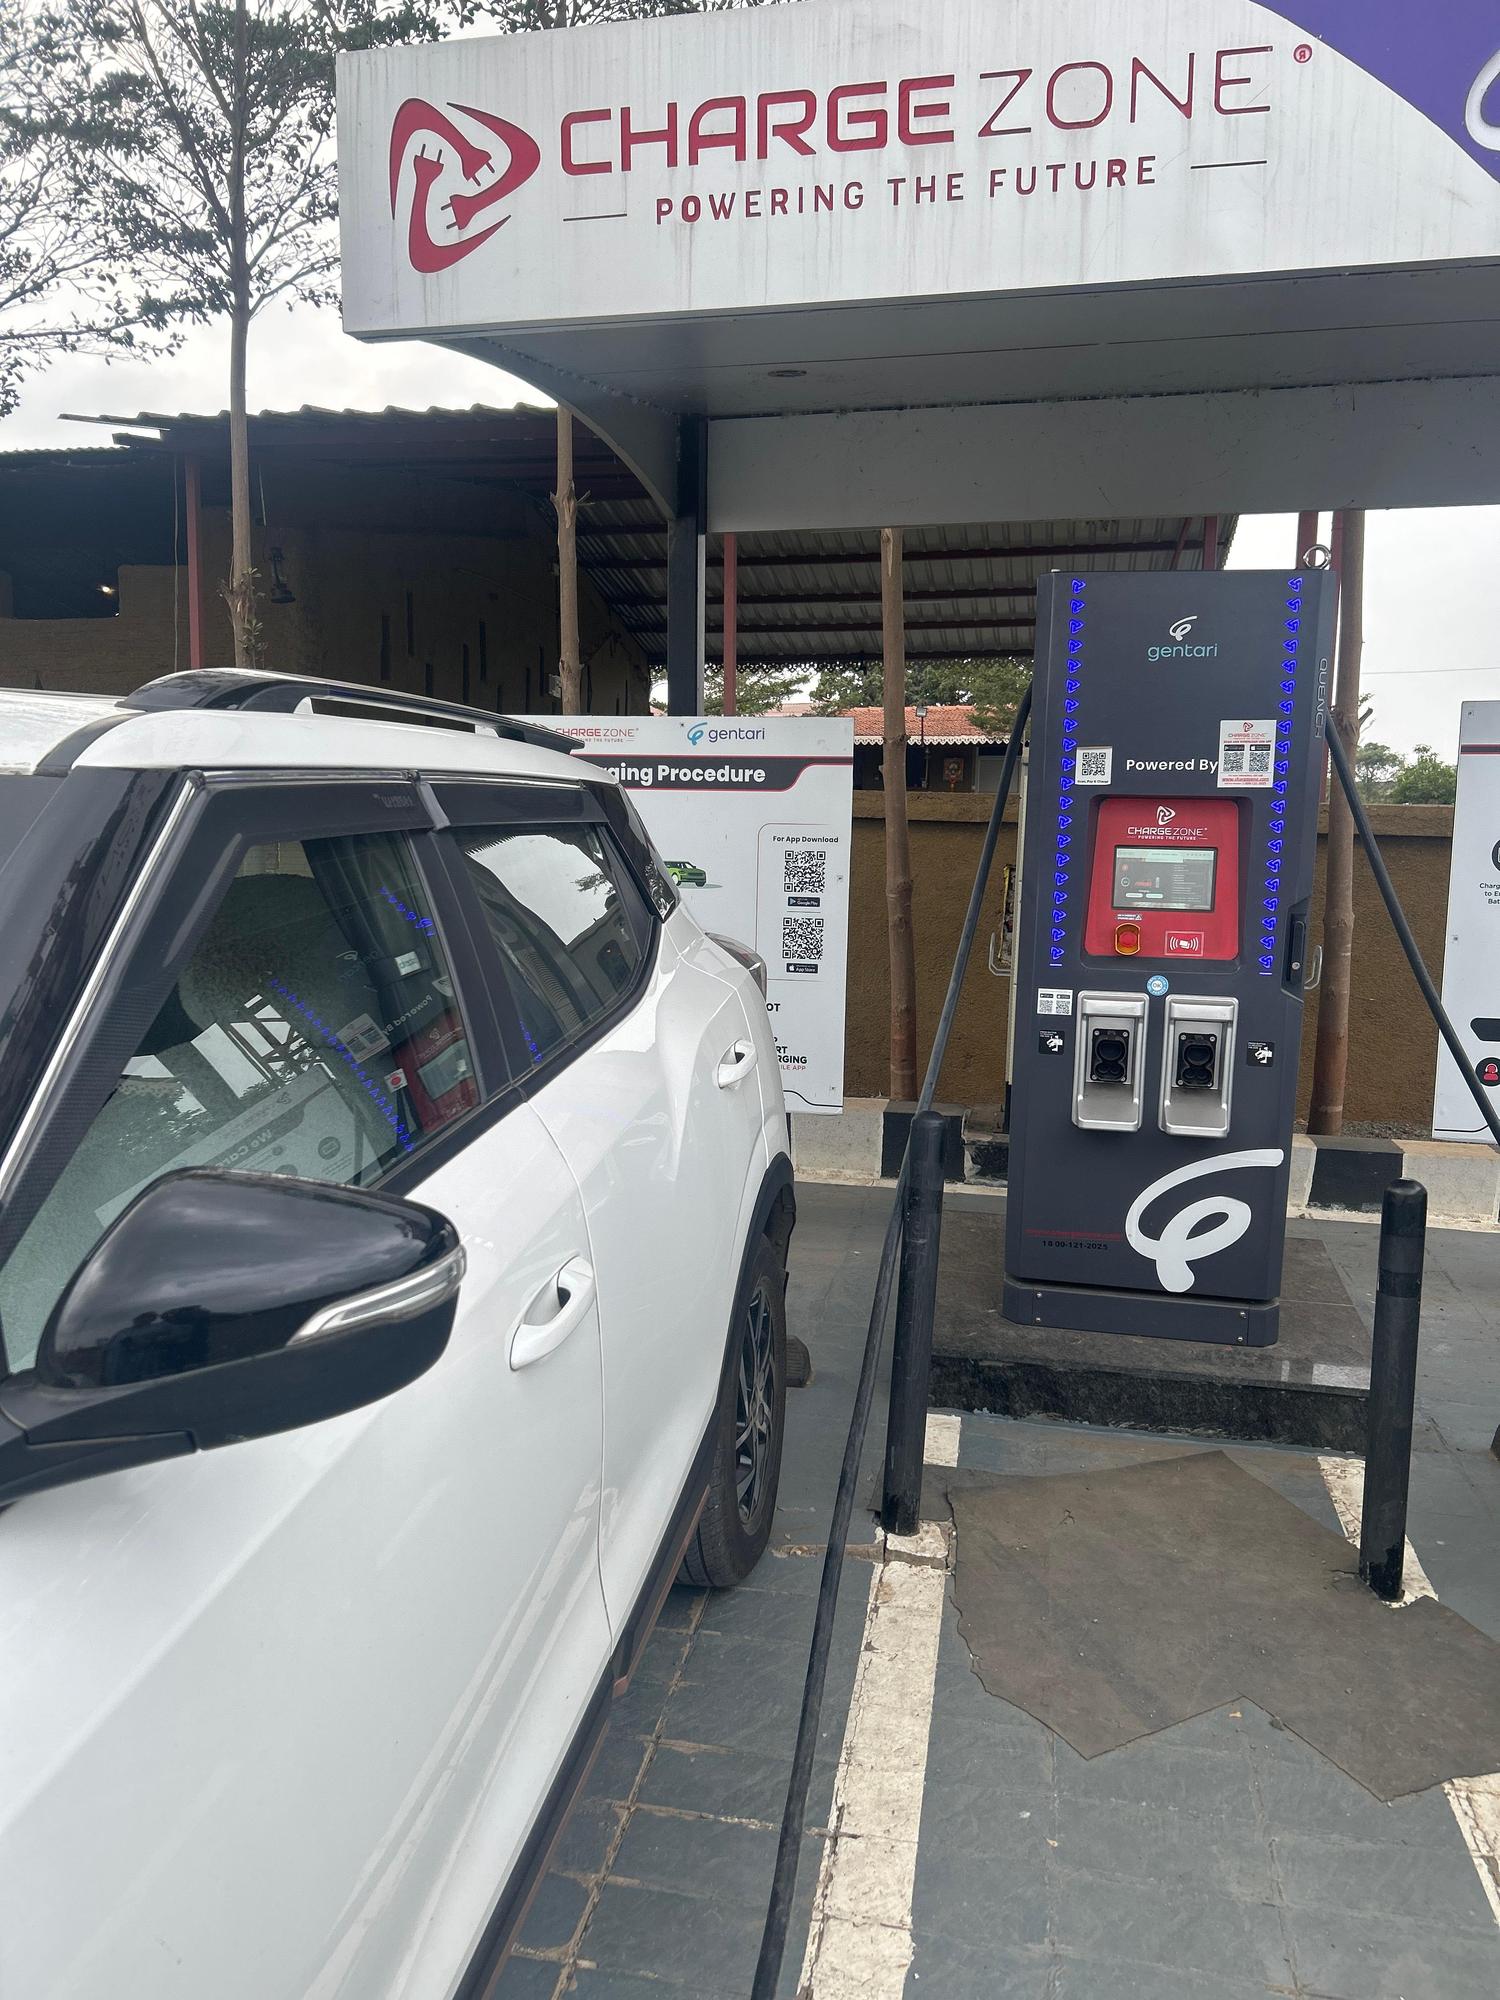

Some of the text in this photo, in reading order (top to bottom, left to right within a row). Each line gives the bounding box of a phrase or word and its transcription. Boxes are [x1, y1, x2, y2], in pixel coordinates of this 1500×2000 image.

[560, 73, 955, 177] CHARGE
[656, 155, 1157, 226] POWERING THE FUTURE
[1147, 643, 1218, 662] gentari
[1314, 658, 1328, 738] QUENCH
[708, 727, 766, 743] gentari
[657, 764, 766, 783] Procedure
[1126, 759, 1218, 774] Powered By
[772, 835, 839, 844] For App Download
[1127, 827, 1172, 836] CHARGE
[766, 1003, 781, 1012] OT
